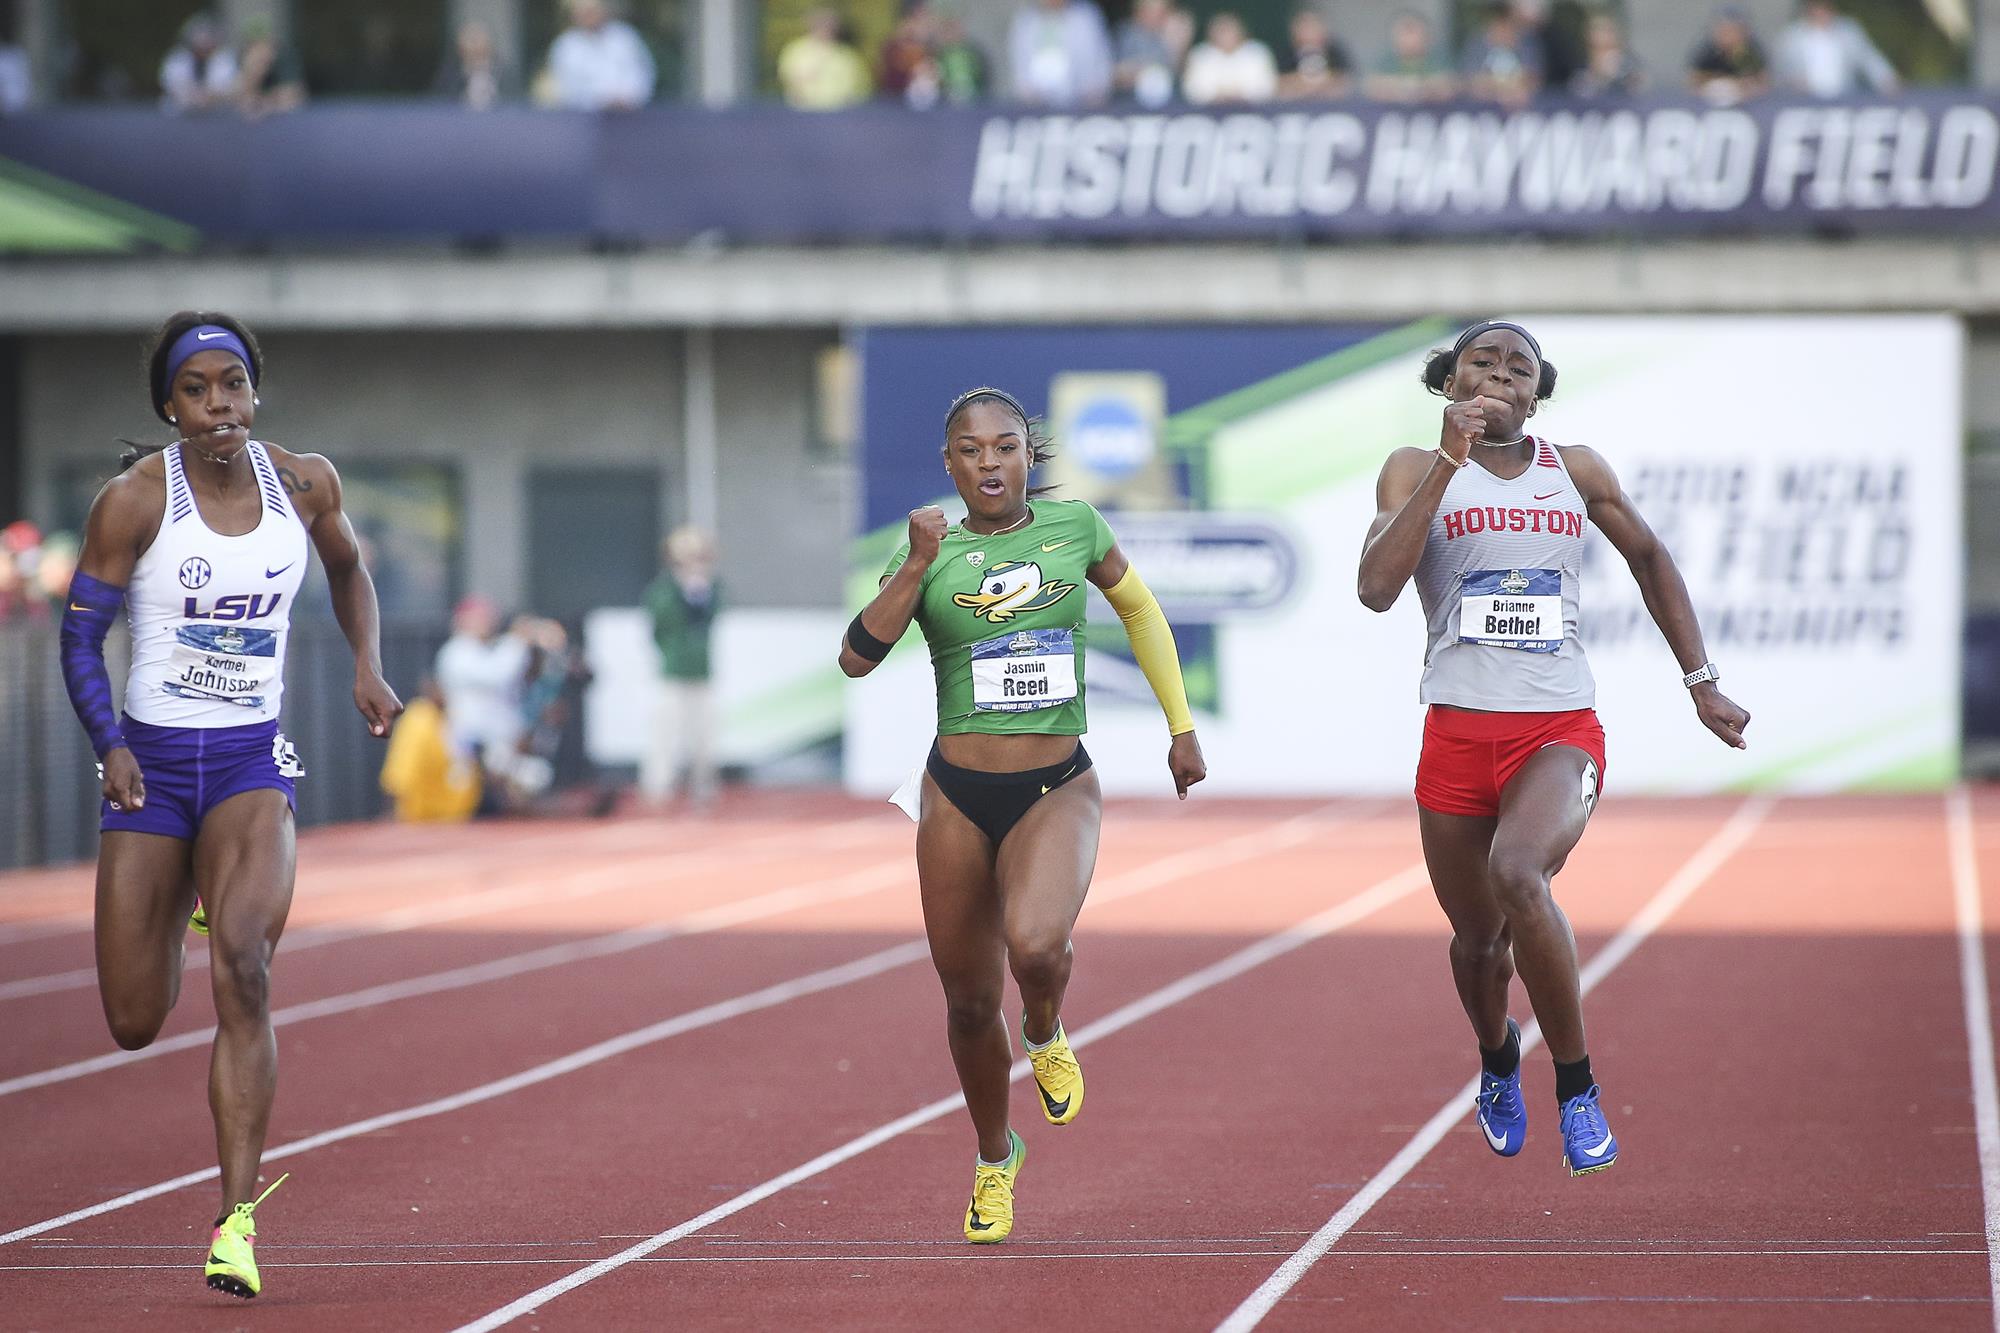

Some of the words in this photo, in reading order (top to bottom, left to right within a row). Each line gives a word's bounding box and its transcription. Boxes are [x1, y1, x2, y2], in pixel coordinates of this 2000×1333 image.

[971, 111, 1364, 216] HISTORIC
[1366, 108, 1758, 213] HAYWARD
[1762, 106, 1998, 210] FIELD
[1443, 507, 1583, 541] HOUSTON
[180, 558, 211, 588] SEC
[183, 593, 283, 621] LSU
[1493, 600, 1535, 613] Brianne
[1485, 616, 1540, 635] Bethel
[180, 665, 259, 692] Johnson
[1004, 661, 1046, 675] Jasmin
[1003, 677, 1049, 697] Reed
